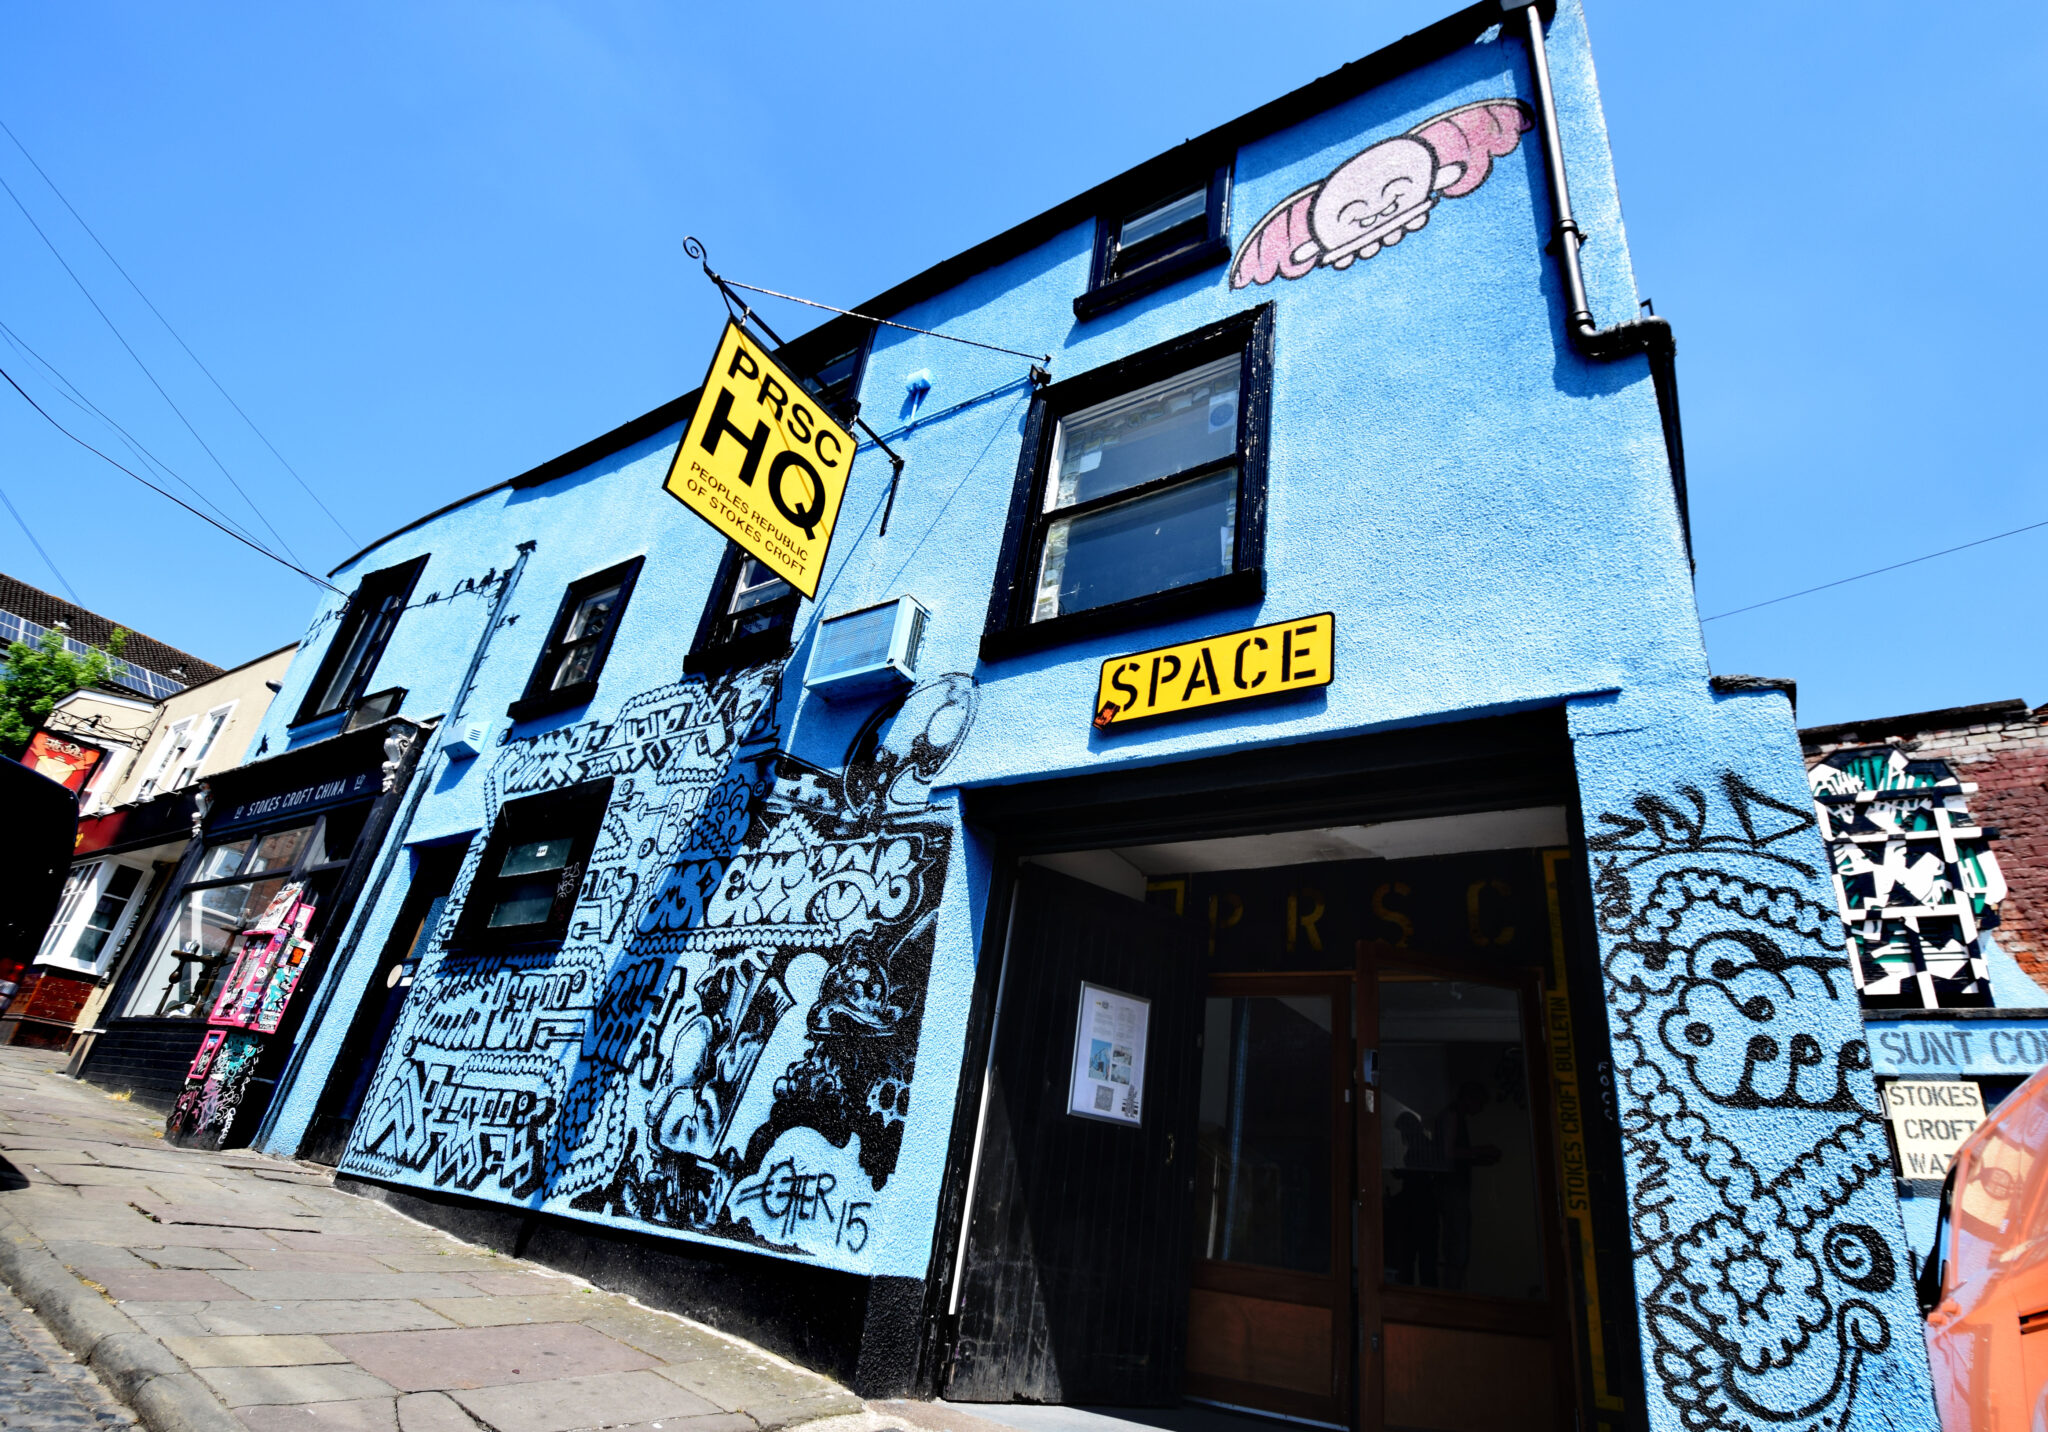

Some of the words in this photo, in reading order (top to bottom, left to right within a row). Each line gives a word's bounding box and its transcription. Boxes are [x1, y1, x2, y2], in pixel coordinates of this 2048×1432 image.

[728, 345, 842, 469] PRSC
[700, 386, 826, 541] HQ
[687, 478, 708, 498] OF
[709, 492, 762, 543] STOKES
[765, 540, 807, 577] CROFT
[690, 461, 749, 514] PEOPLES
[751, 510, 809, 562] REPUBLIC
[1111, 624, 1318, 712] SPACE
[247, 796, 281, 817] STOKES
[282, 787, 314, 808] CROFT
[315, 779, 347, 800] CHINA
[1551, 996, 1574, 1074] BULLETIN
[1879, 1031, 1973, 1066] SUNT
[1889, 1085, 1979, 1108] STOKES
[1903, 1118, 1977, 1141] CROFT
[1563, 1142, 1588, 1211] STOKES
